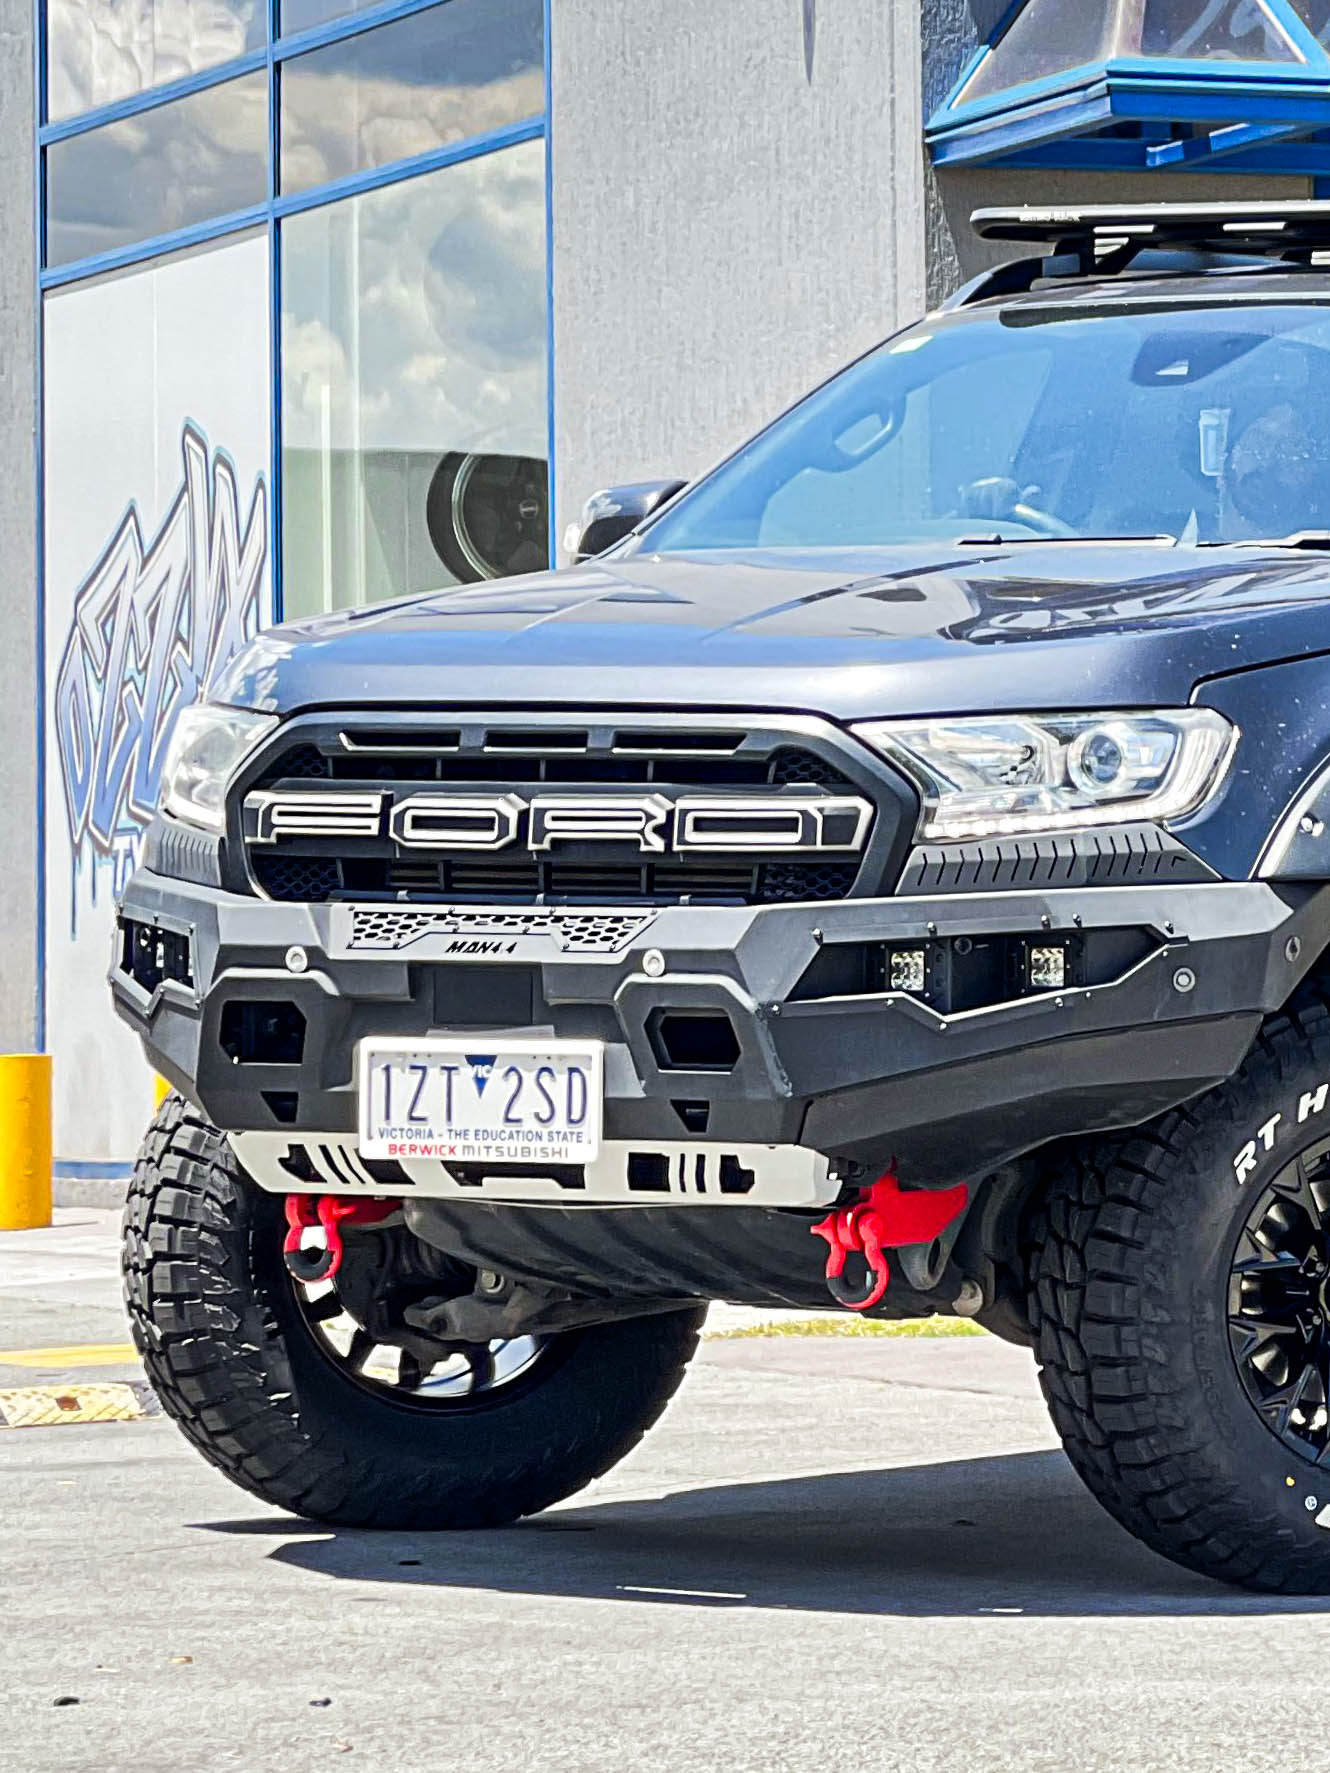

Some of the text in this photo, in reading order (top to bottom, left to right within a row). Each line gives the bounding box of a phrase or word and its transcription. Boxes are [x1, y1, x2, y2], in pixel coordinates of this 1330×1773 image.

[244, 791, 874, 852] FORD
[381, 1064, 459, 1123] 1ZT
[503, 1066, 587, 1125] 2SD
[378, 1127, 433, 1141] VICTORIA
[447, 1128, 471, 1141] THE
[474, 1129, 543, 1142] EDUCATION
[547, 1130, 583, 1143] STATE
[388, 1143, 568, 1159] BERWICK MITSUBISHI
[1233, 1114, 1281, 1184] RT
